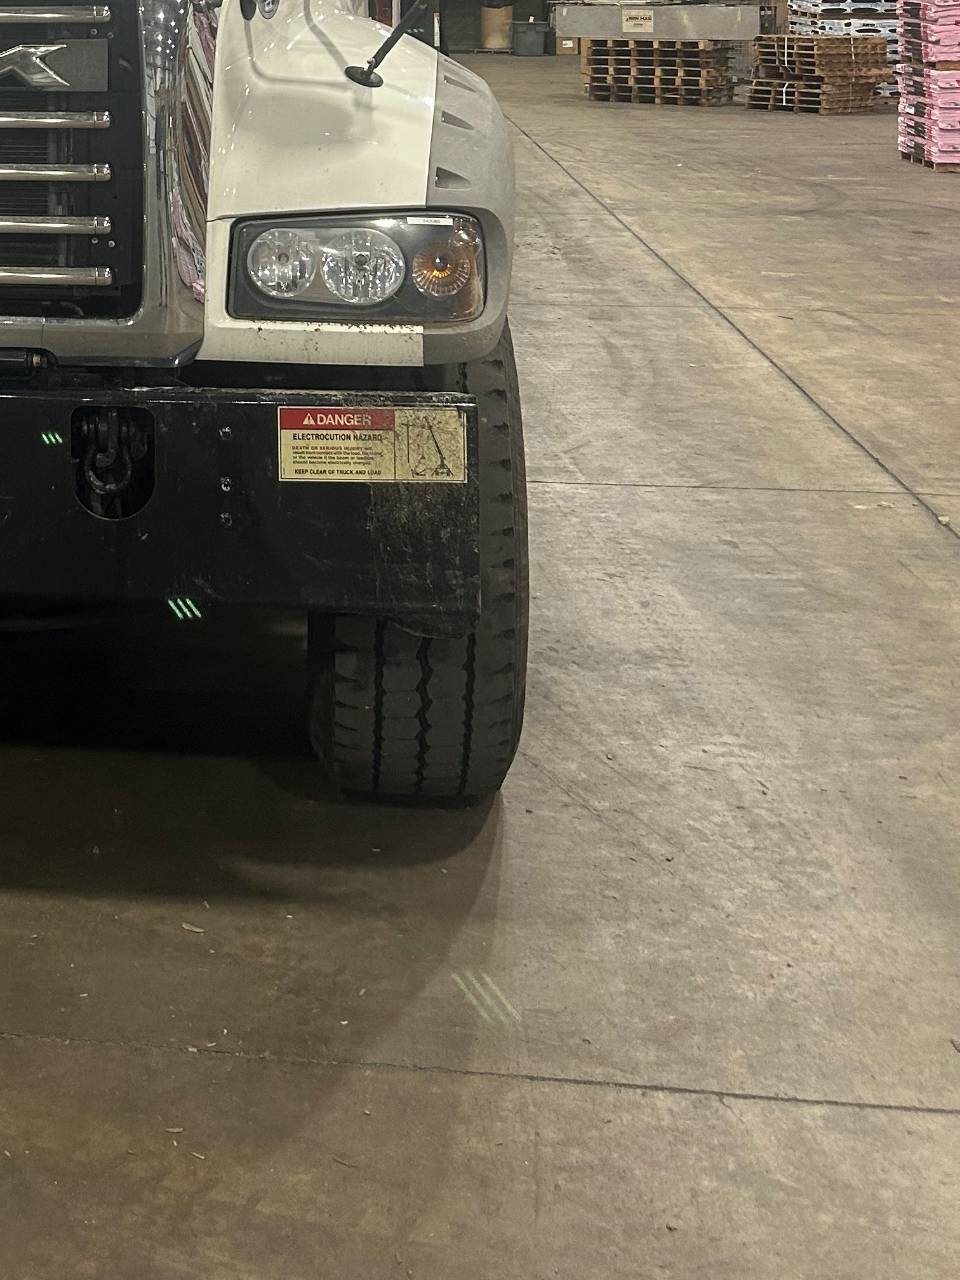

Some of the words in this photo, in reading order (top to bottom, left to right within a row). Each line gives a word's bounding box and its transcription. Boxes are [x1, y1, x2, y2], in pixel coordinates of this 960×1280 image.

[317, 413, 372, 426] DANGER
[293, 433, 351, 441] ELECTROCUTION
[353, 433, 383, 441] HAZARD
